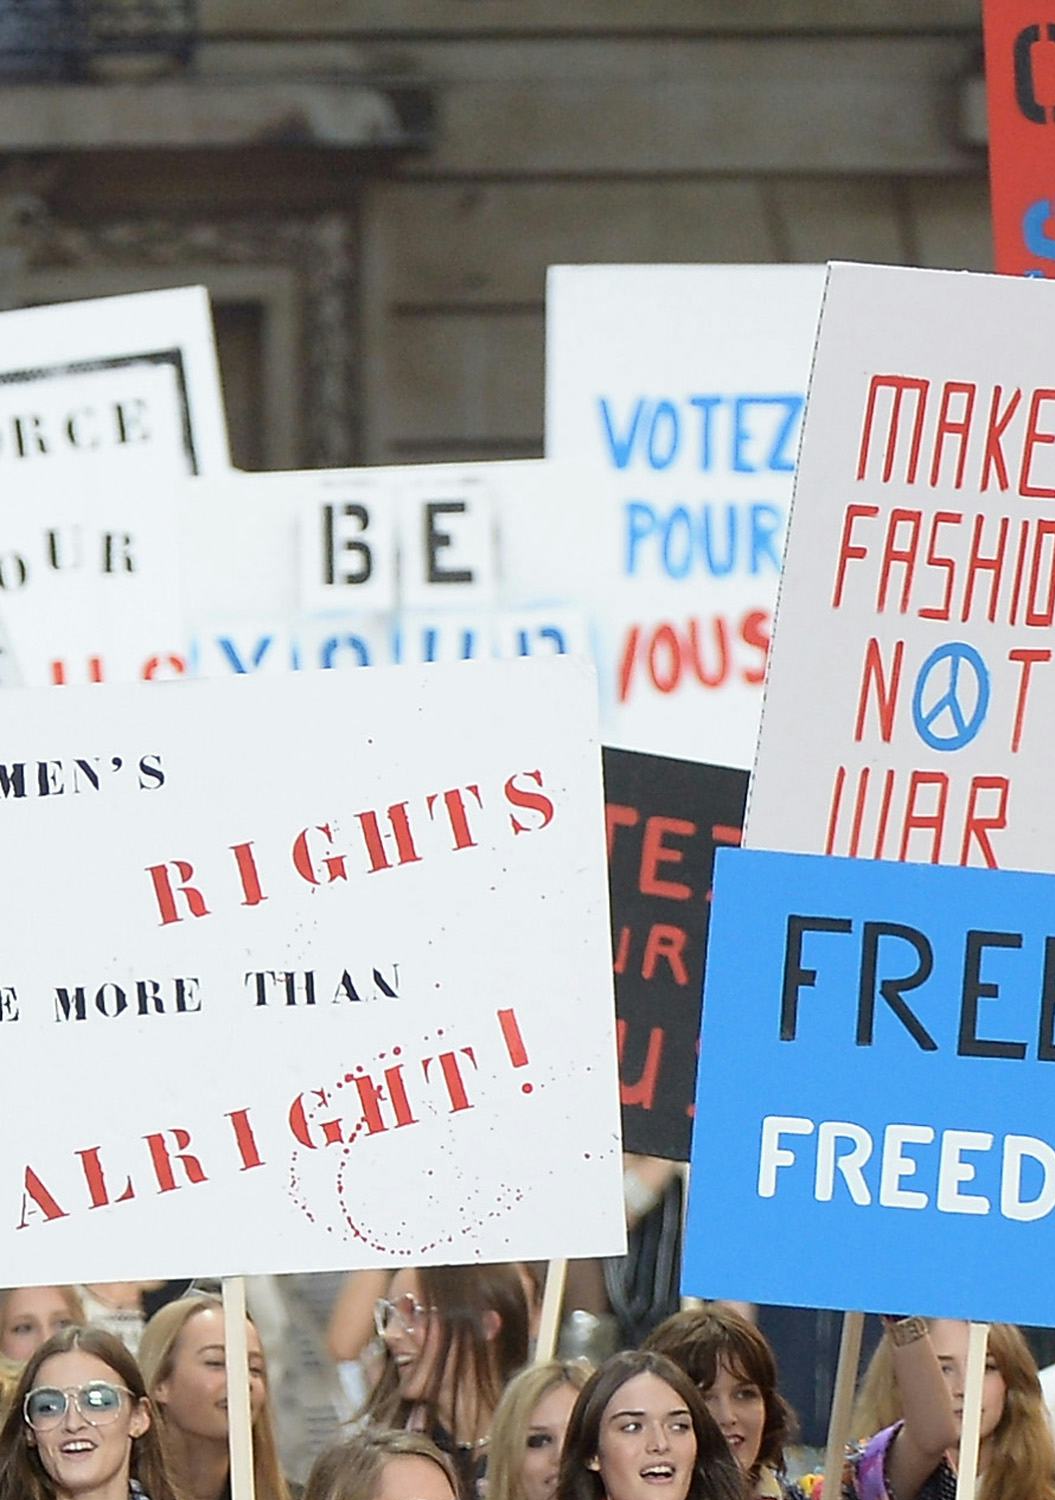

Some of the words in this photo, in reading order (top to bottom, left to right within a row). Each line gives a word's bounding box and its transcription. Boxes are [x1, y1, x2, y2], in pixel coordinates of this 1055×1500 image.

[598, 394, 804, 473] VOTEZ
[322, 500, 475, 586] BE
[625, 502, 781, 579] POUR
[144, 769, 555, 926] RIGHTS
[825, 766, 1010, 869] WAR
[54, 977, 202, 1023] MORE
[245, 963, 402, 1008] THAN
